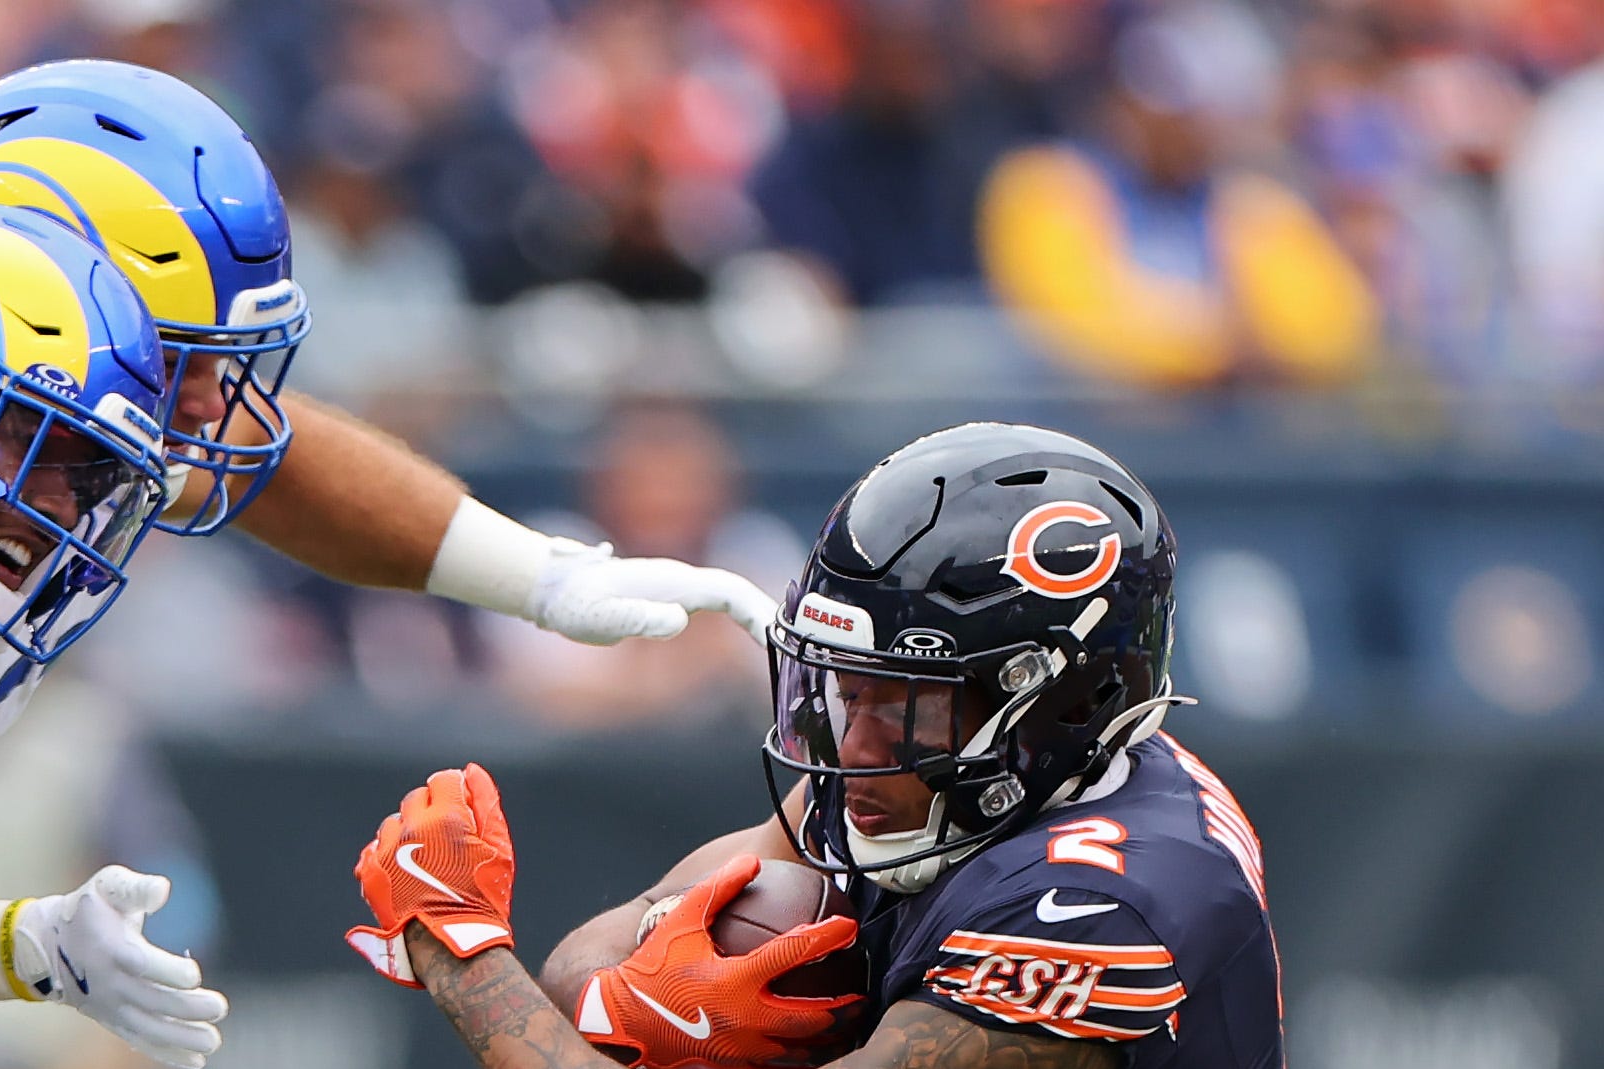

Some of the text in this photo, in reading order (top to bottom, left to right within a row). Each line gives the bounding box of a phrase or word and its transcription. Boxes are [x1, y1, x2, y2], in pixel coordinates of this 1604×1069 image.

[999, 500, 1122, 600] C
[803, 604, 854, 632] BEARS
[1047, 815, 1129, 876] 2
[968, 952, 1106, 1020] GSH
